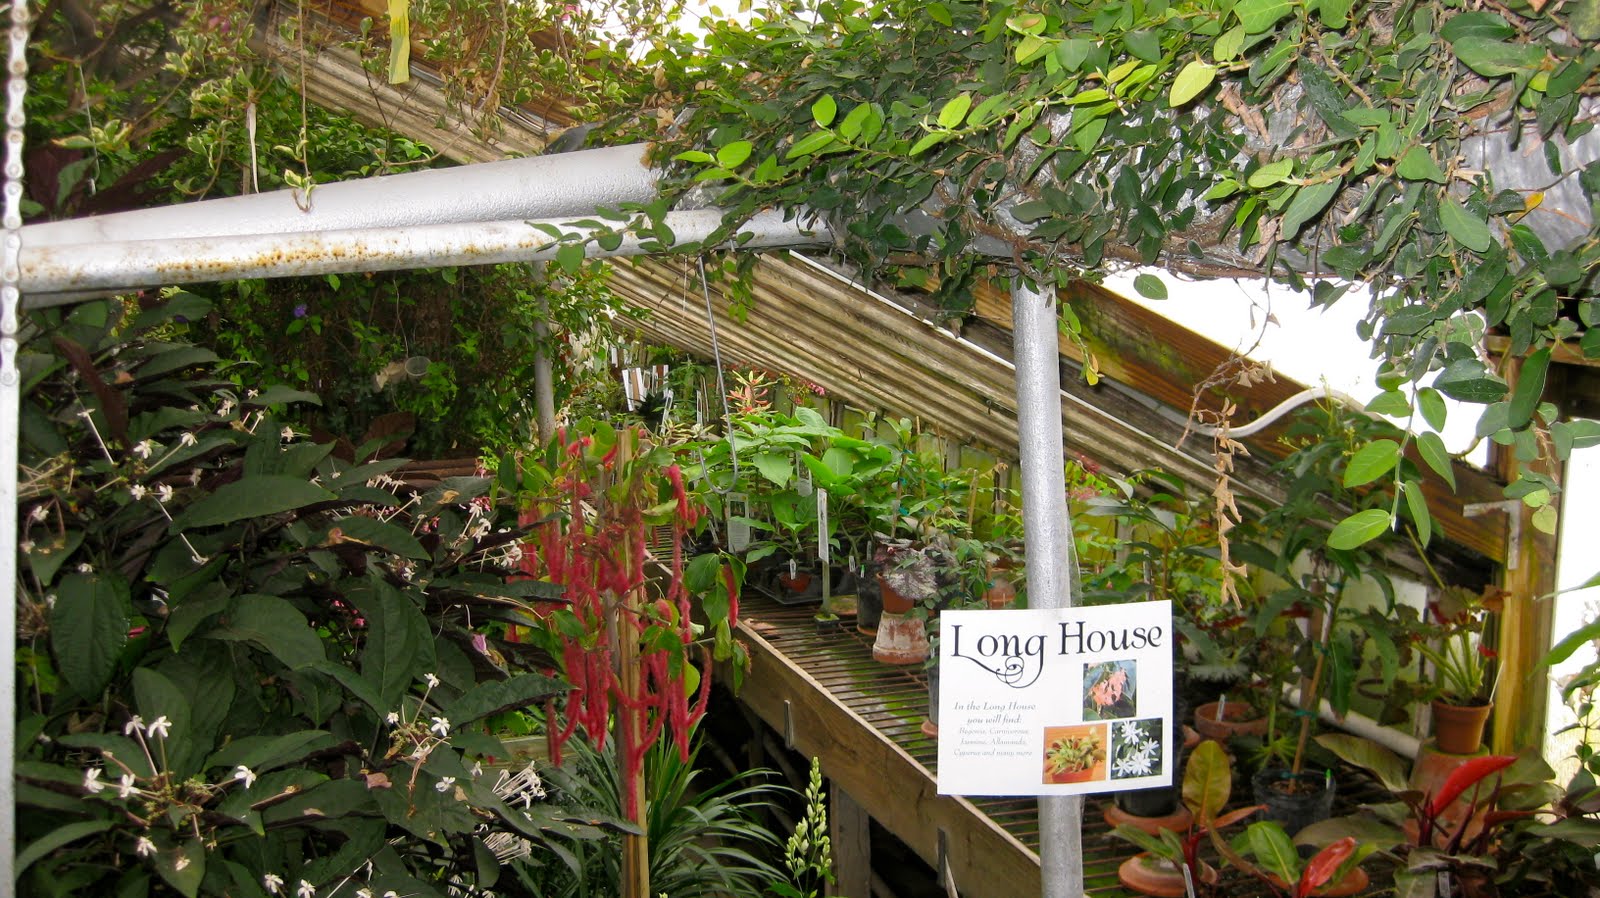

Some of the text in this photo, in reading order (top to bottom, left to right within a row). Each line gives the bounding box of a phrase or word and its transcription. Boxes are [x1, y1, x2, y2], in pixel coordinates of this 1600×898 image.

[951, 621, 1163, 689] Long House
[954, 700, 1036, 713] In the Long House
[967, 717, 983, 725] you
[985, 714, 1002, 724] will
